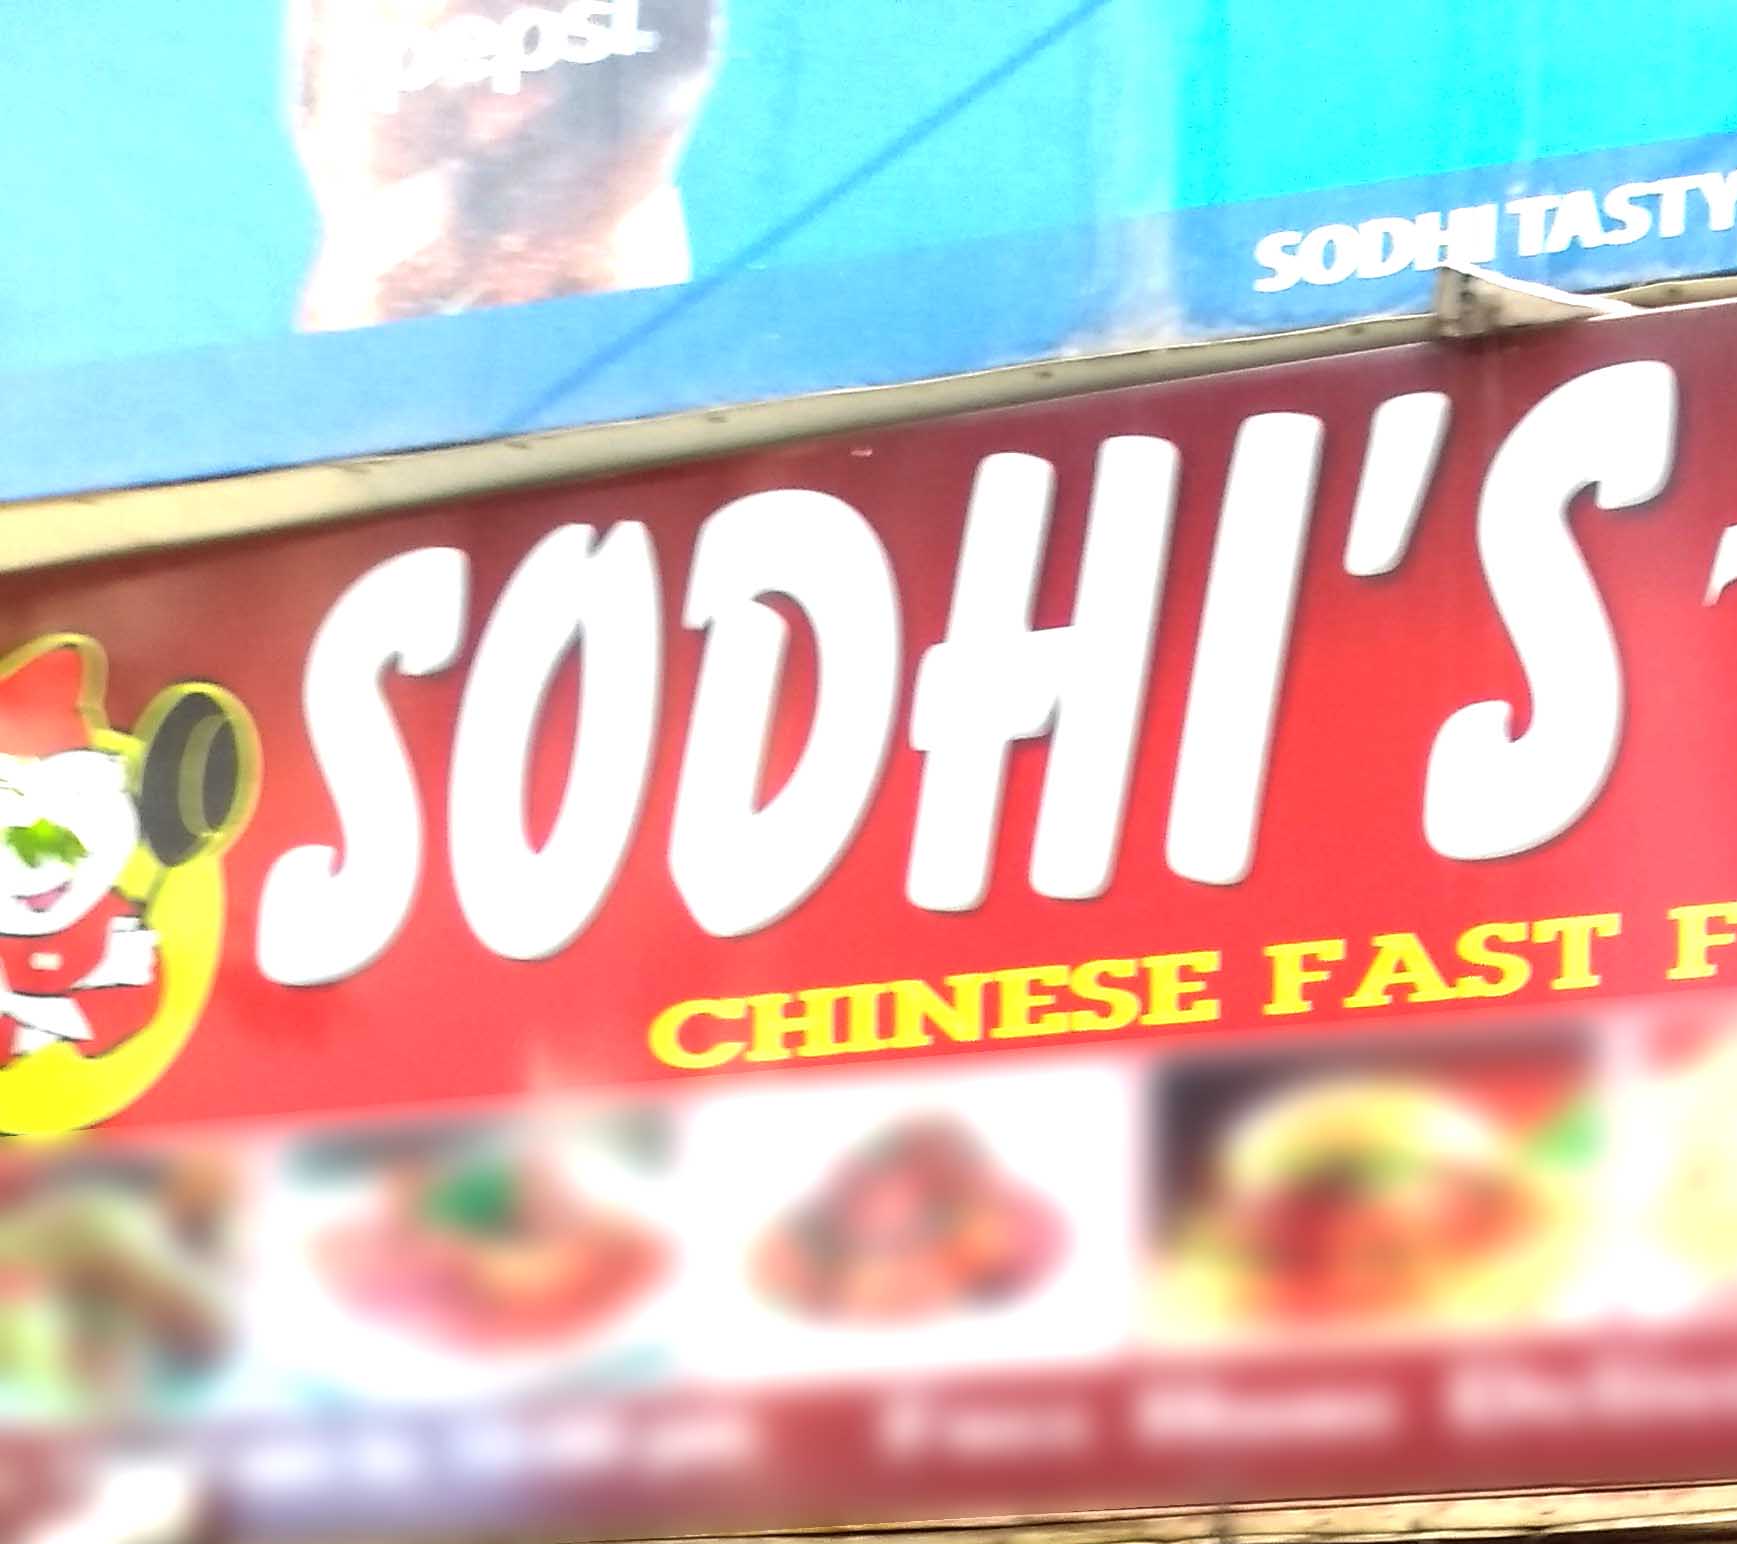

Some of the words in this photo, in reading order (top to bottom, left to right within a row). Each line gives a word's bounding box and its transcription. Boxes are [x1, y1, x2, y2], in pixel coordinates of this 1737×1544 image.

[1253, 202, 1497, 293] SODHI
[256, 360, 1679, 988] SODHI'S
[648, 950, 1221, 1070] CHINESE
[1263, 912, 1621, 1016] FAST
